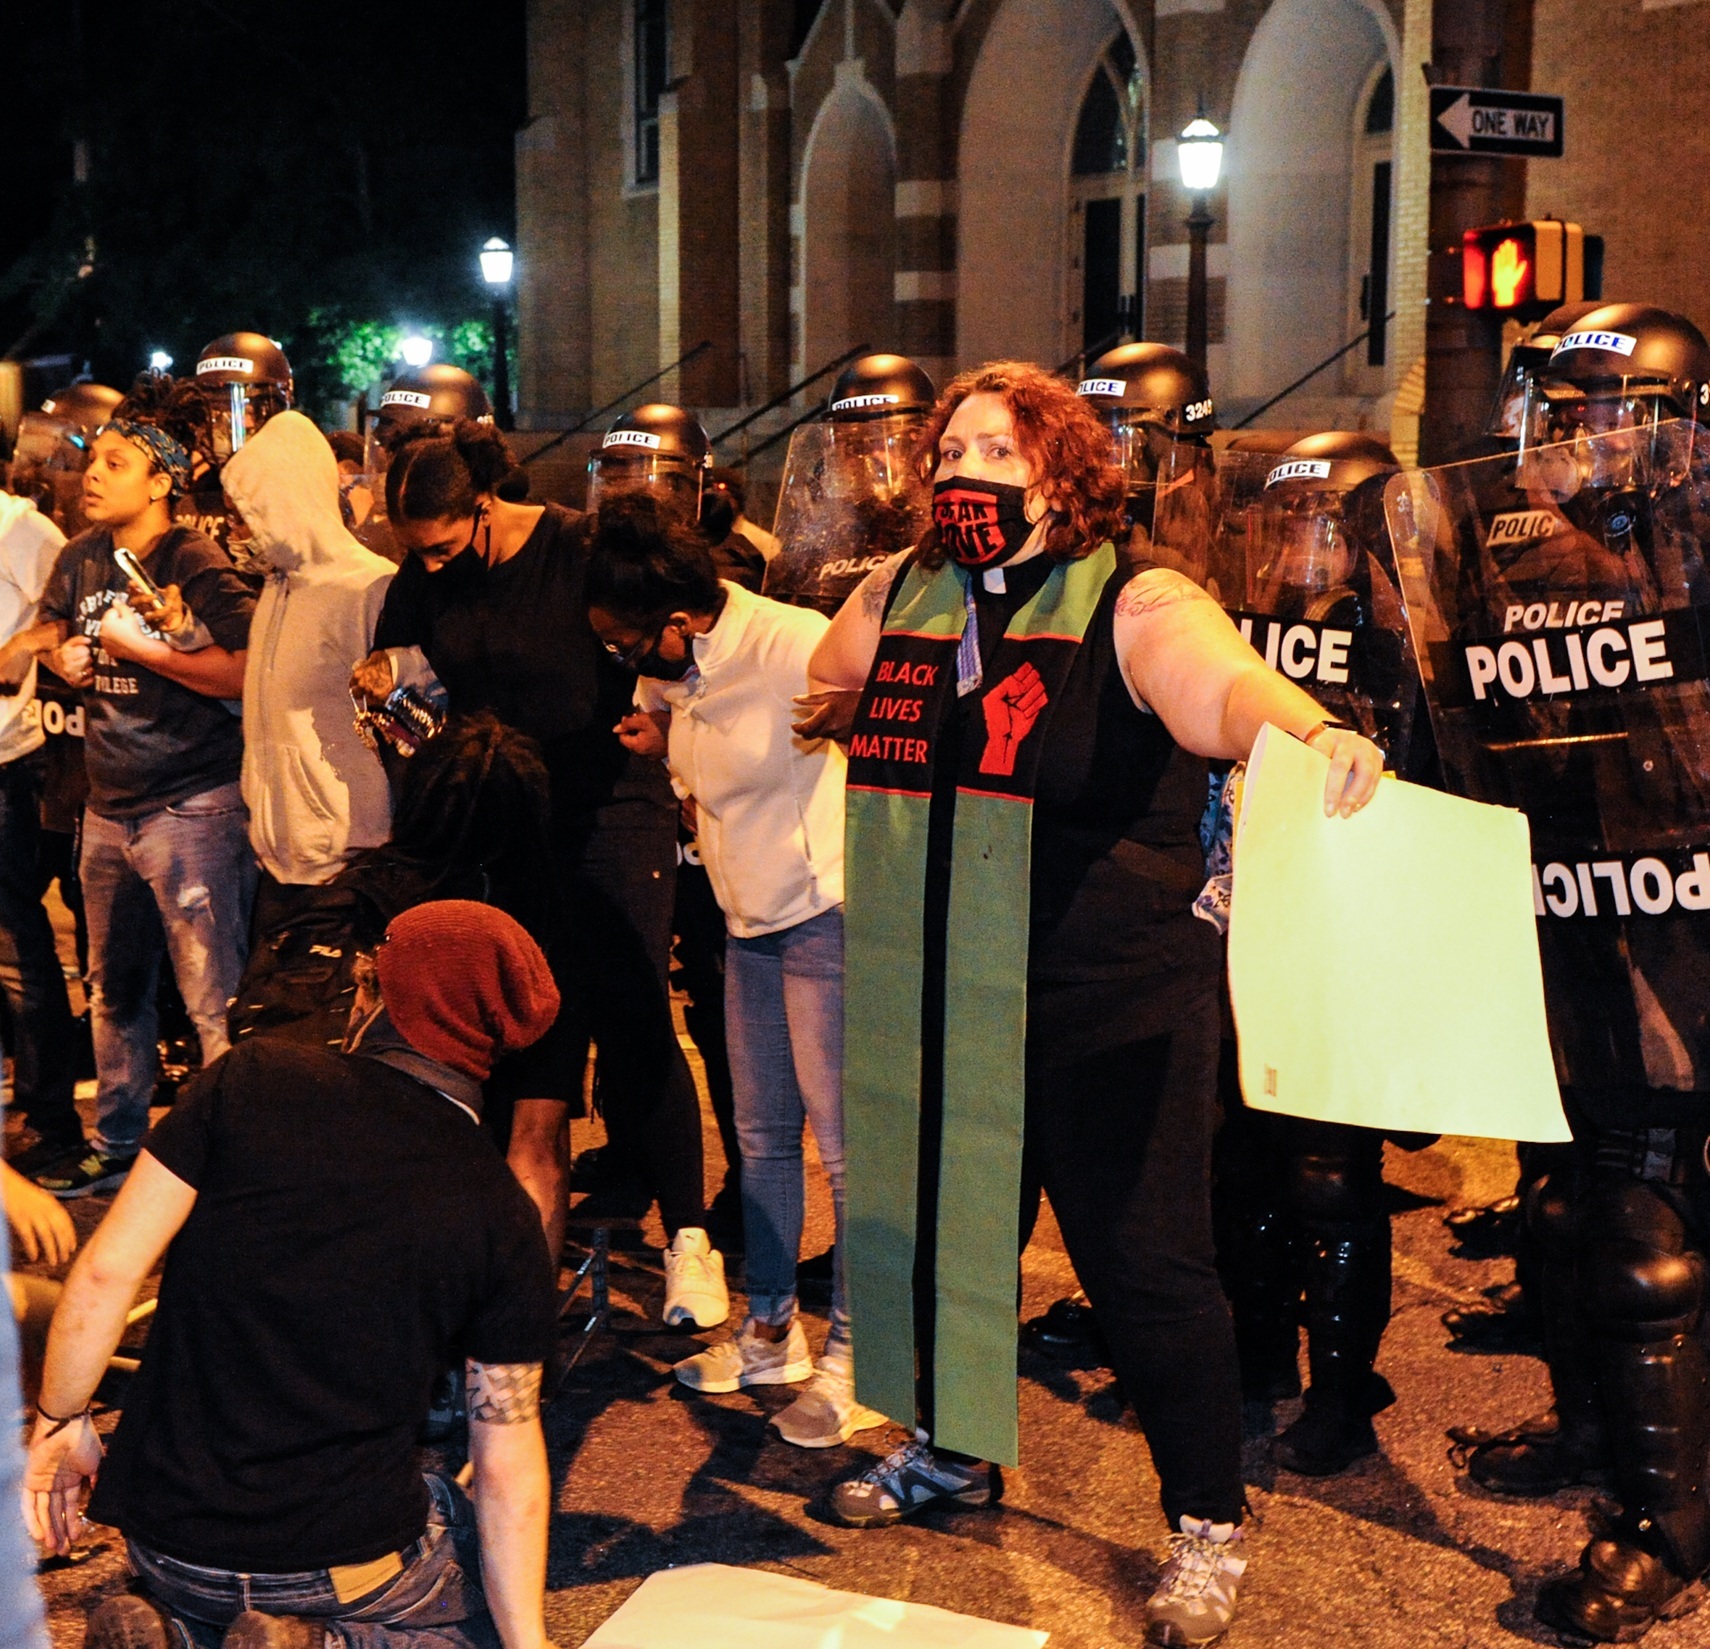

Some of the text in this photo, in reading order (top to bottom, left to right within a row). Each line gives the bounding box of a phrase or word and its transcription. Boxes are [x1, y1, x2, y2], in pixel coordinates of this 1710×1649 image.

[1472, 111, 1550, 137] ONE WAY
[1555, 334, 1627, 353] POLICE
[199, 360, 245, 371] POLICE
[604, 433, 653, 446] POLICE
[1269, 462, 1322, 481] OLICE
[819, 555, 890, 580] POLIC
[1503, 601, 1625, 632] POLICE
[1239, 618, 1353, 683] LICE
[1465, 620, 1674, 700] POLICE
[875, 661, 939, 686] BLACK
[869, 698, 923, 722] LIVES
[850, 734, 928, 764] MATTER
